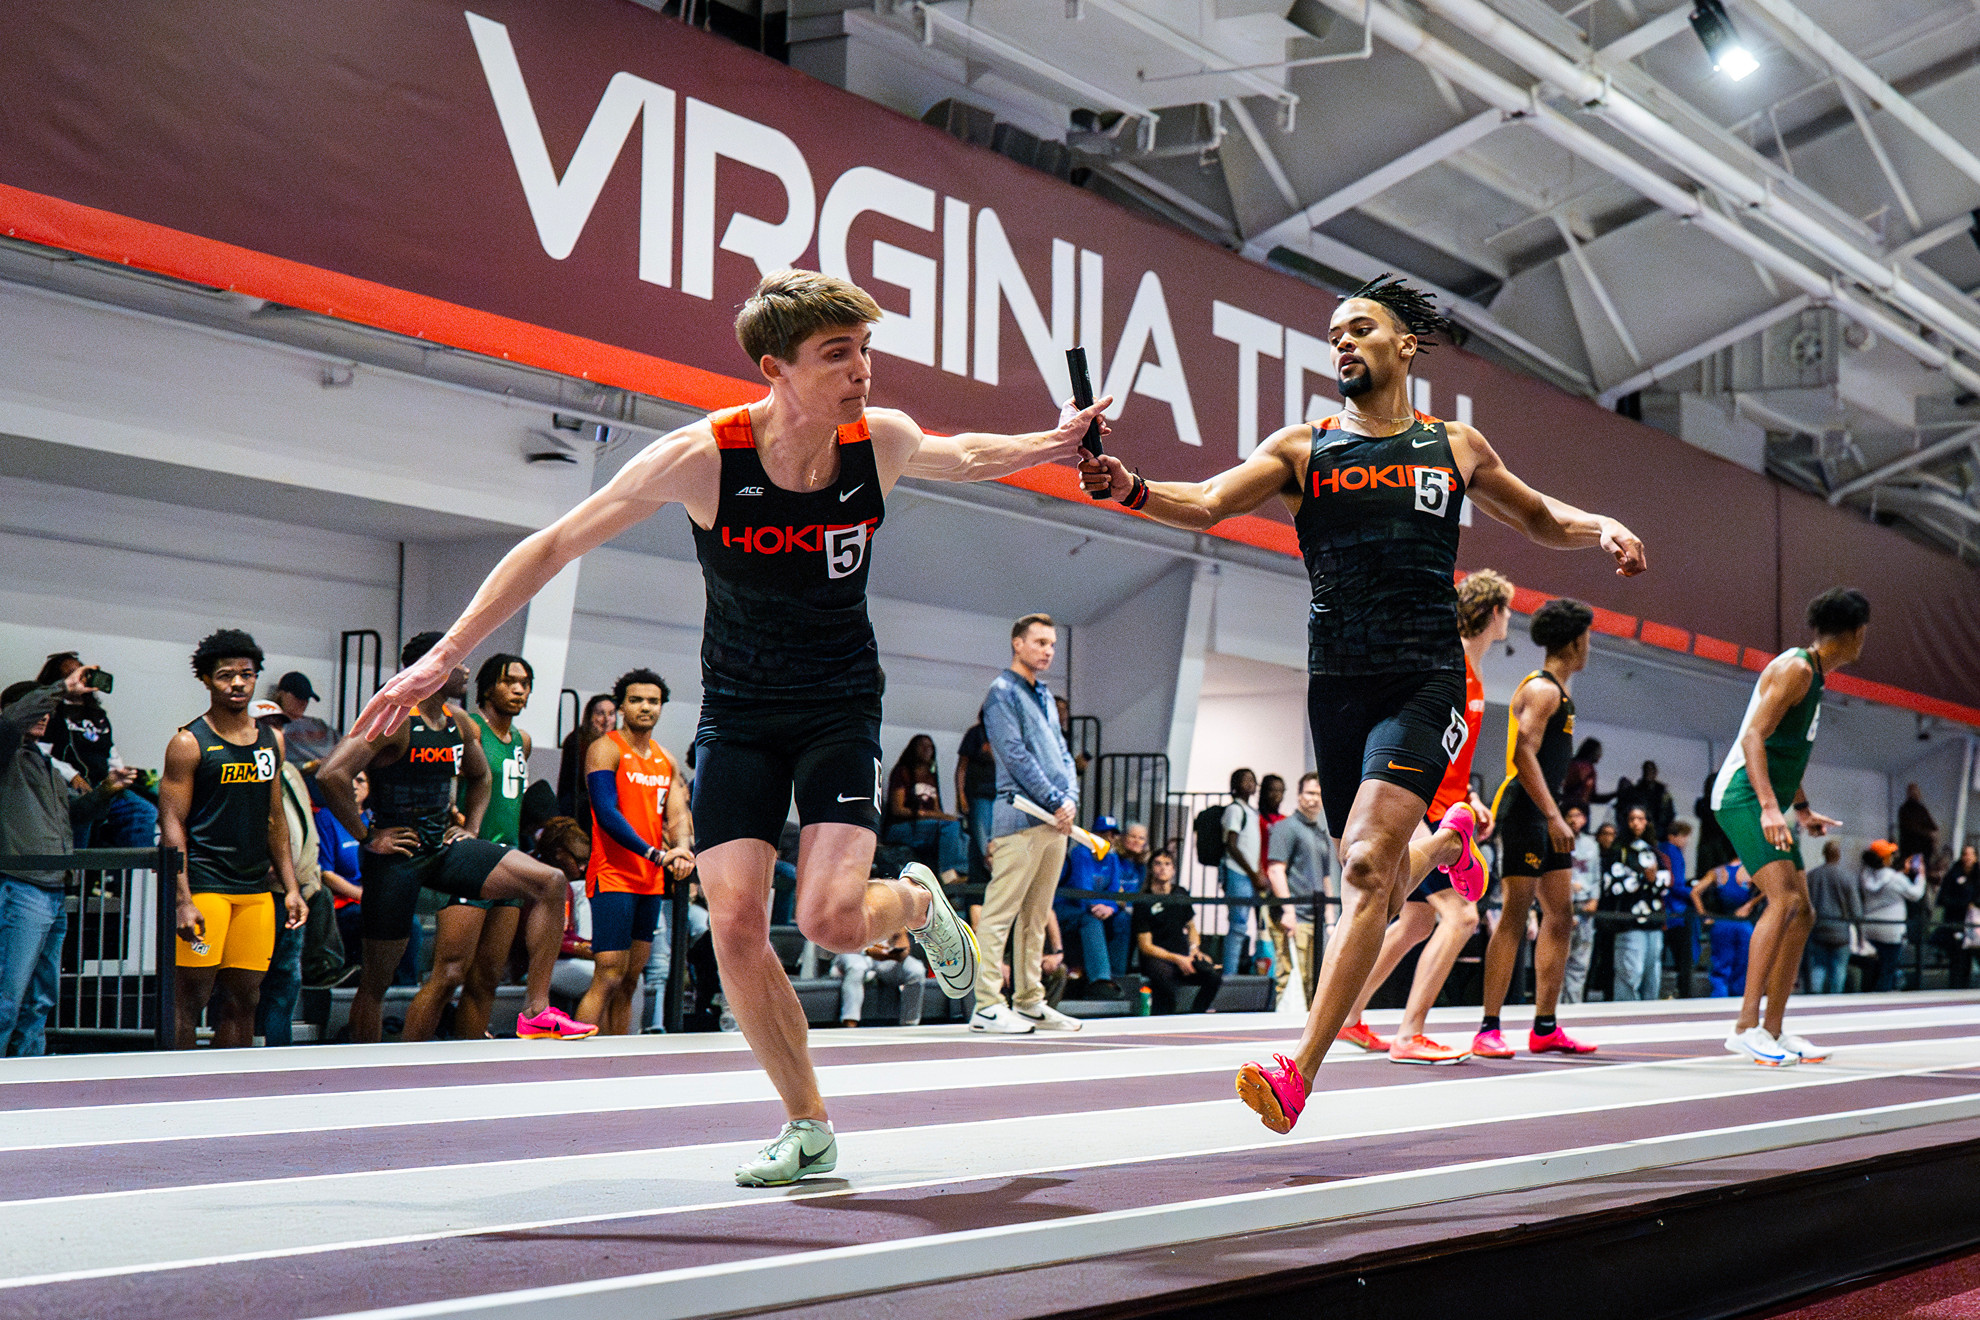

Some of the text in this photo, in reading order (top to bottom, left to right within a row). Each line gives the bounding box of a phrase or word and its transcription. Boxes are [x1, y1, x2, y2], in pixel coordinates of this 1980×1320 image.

[463, 10, 1474, 528] VIRGINIA TE
[735, 486, 765, 496] ACC
[1420, 470, 1443, 512] 5
[832, 529, 861, 574] 5
[1446, 713, 1466, 755] 5
[258, 752, 272, 778] 3
[410, 747, 455, 763] HOKI
[221, 763, 263, 784] RAM
